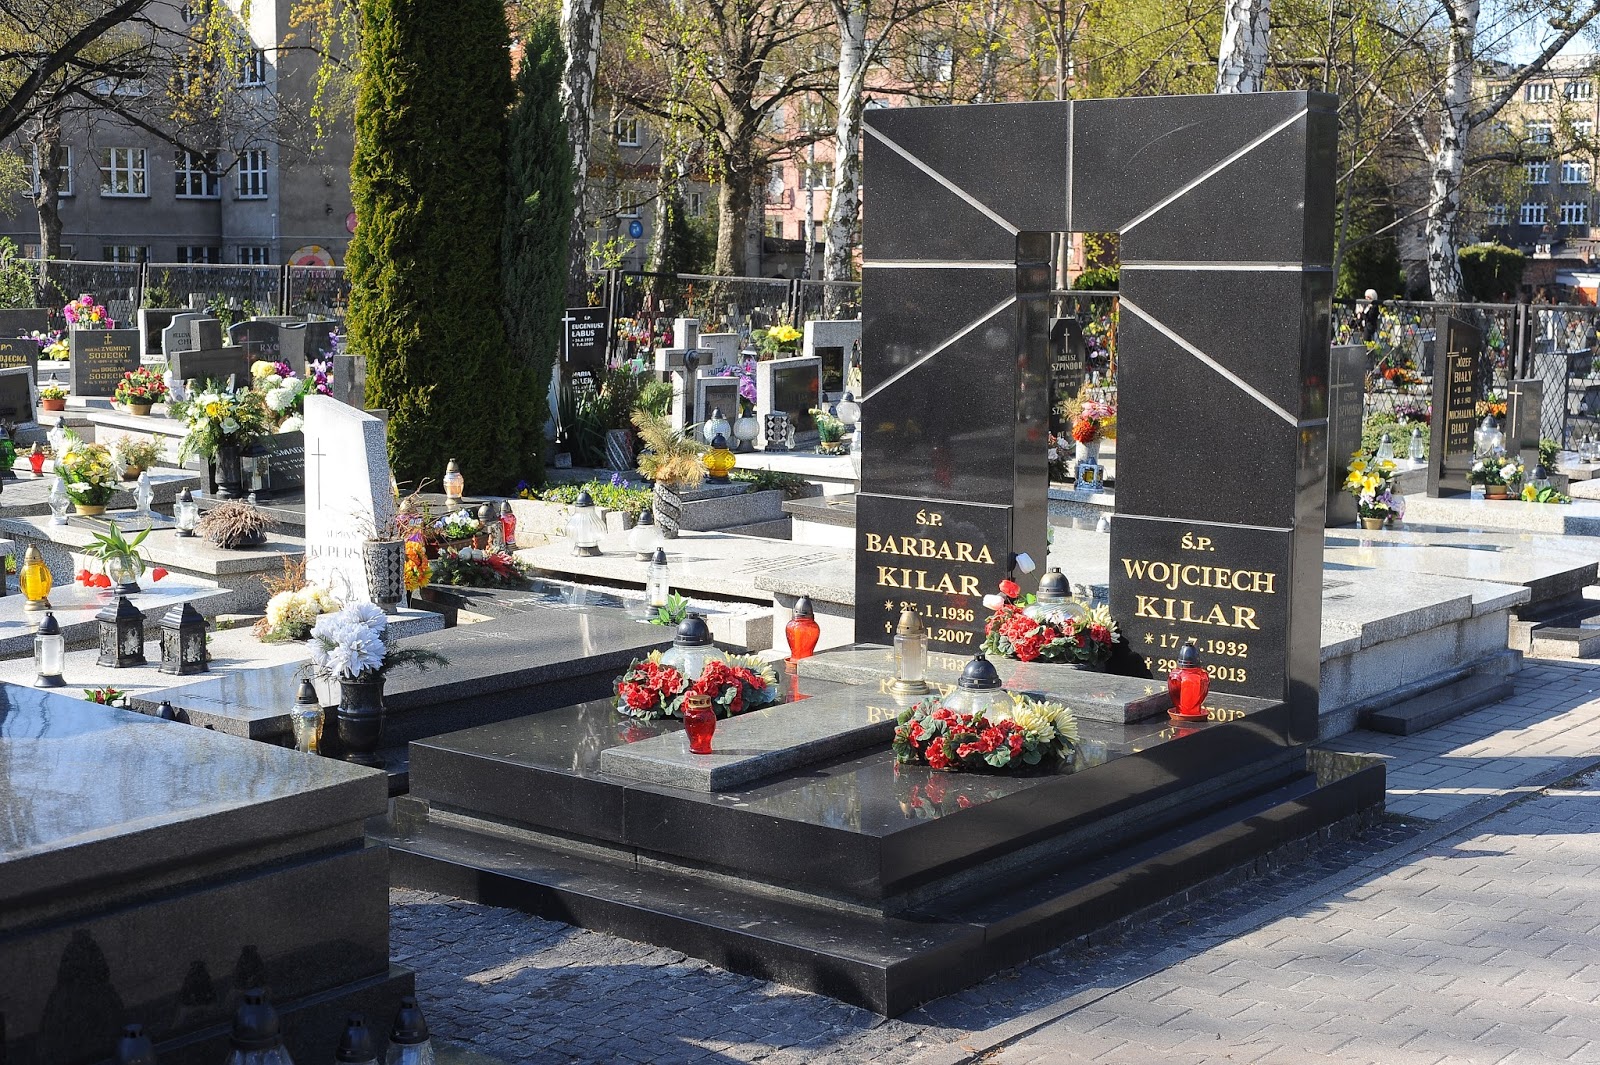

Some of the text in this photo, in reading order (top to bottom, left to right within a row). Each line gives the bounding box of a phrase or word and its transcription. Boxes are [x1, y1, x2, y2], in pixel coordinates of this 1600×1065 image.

[571, 322, 604, 330] EUGENIUSZ
[571, 330, 595, 338] ŁABUS
[916, 509, 943, 526] Ś.P.
[865, 533, 995, 564] BARBARA
[1181, 532, 1215, 551] Ś.P.
[876, 566, 982, 597] KILAR
[1121, 558, 1276, 594] WOJCIECH
[1135, 595, 1260, 630] KILAR
[1160, 633, 1248, 658] 177.1932
